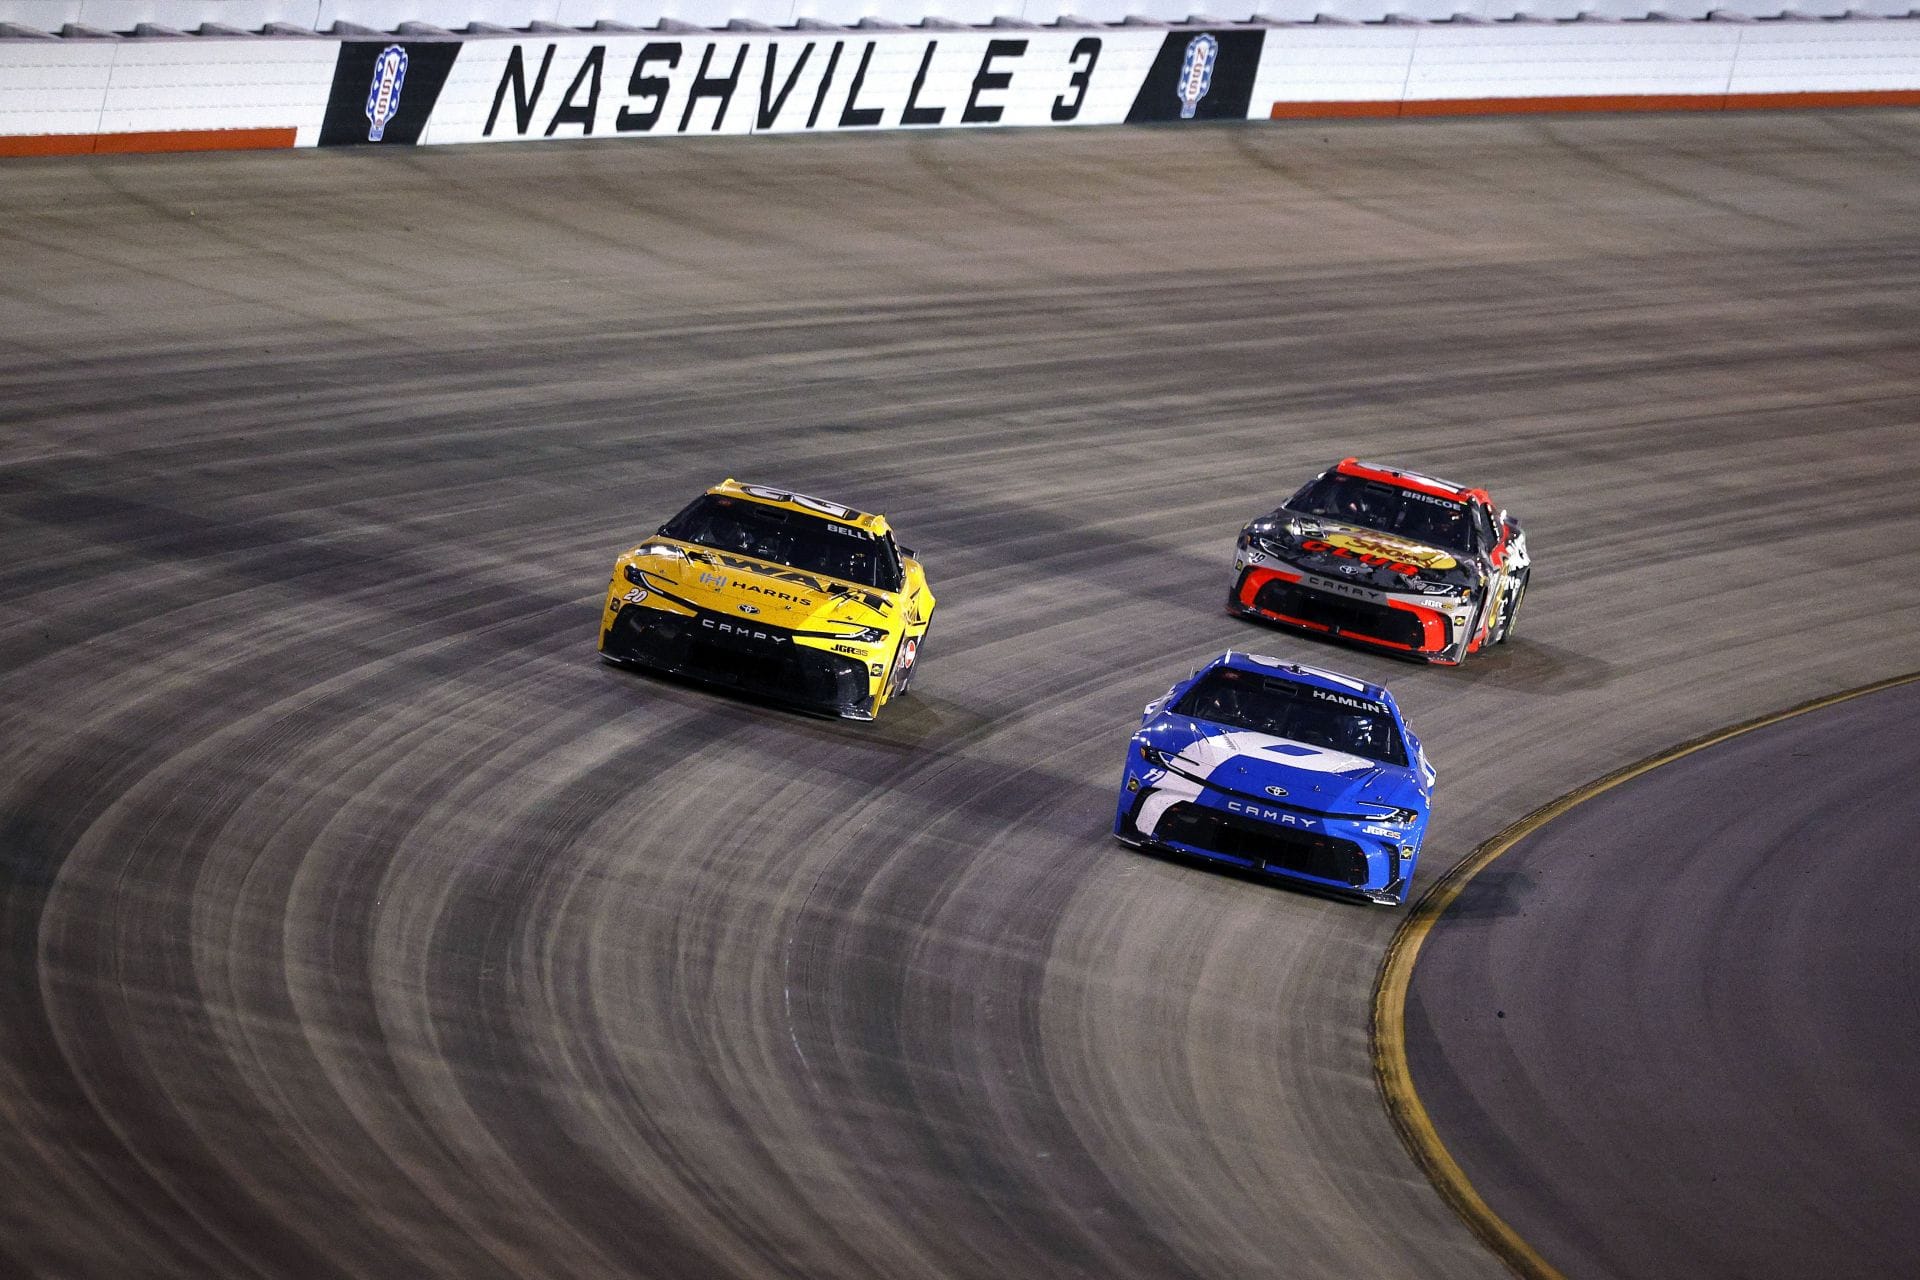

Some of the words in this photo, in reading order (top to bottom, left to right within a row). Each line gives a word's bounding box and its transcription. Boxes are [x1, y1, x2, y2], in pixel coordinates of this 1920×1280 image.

[482, 39, 1029, 136] NASHVILLE
[1050, 37, 1103, 122] 3
[1401, 490, 1461, 511] BRISCOE
[827, 524, 867, 541] BELL
[1301, 539, 1419, 576] CLUB
[623, 587, 648, 603] 20
[732, 580, 812, 607] HARRIS
[1309, 576, 1382, 598] CAMRY
[702, 618, 787, 642] CAMRY
[1313, 690, 1380, 714] HAMLIN
[1227, 801, 1317, 828] CAMRY
